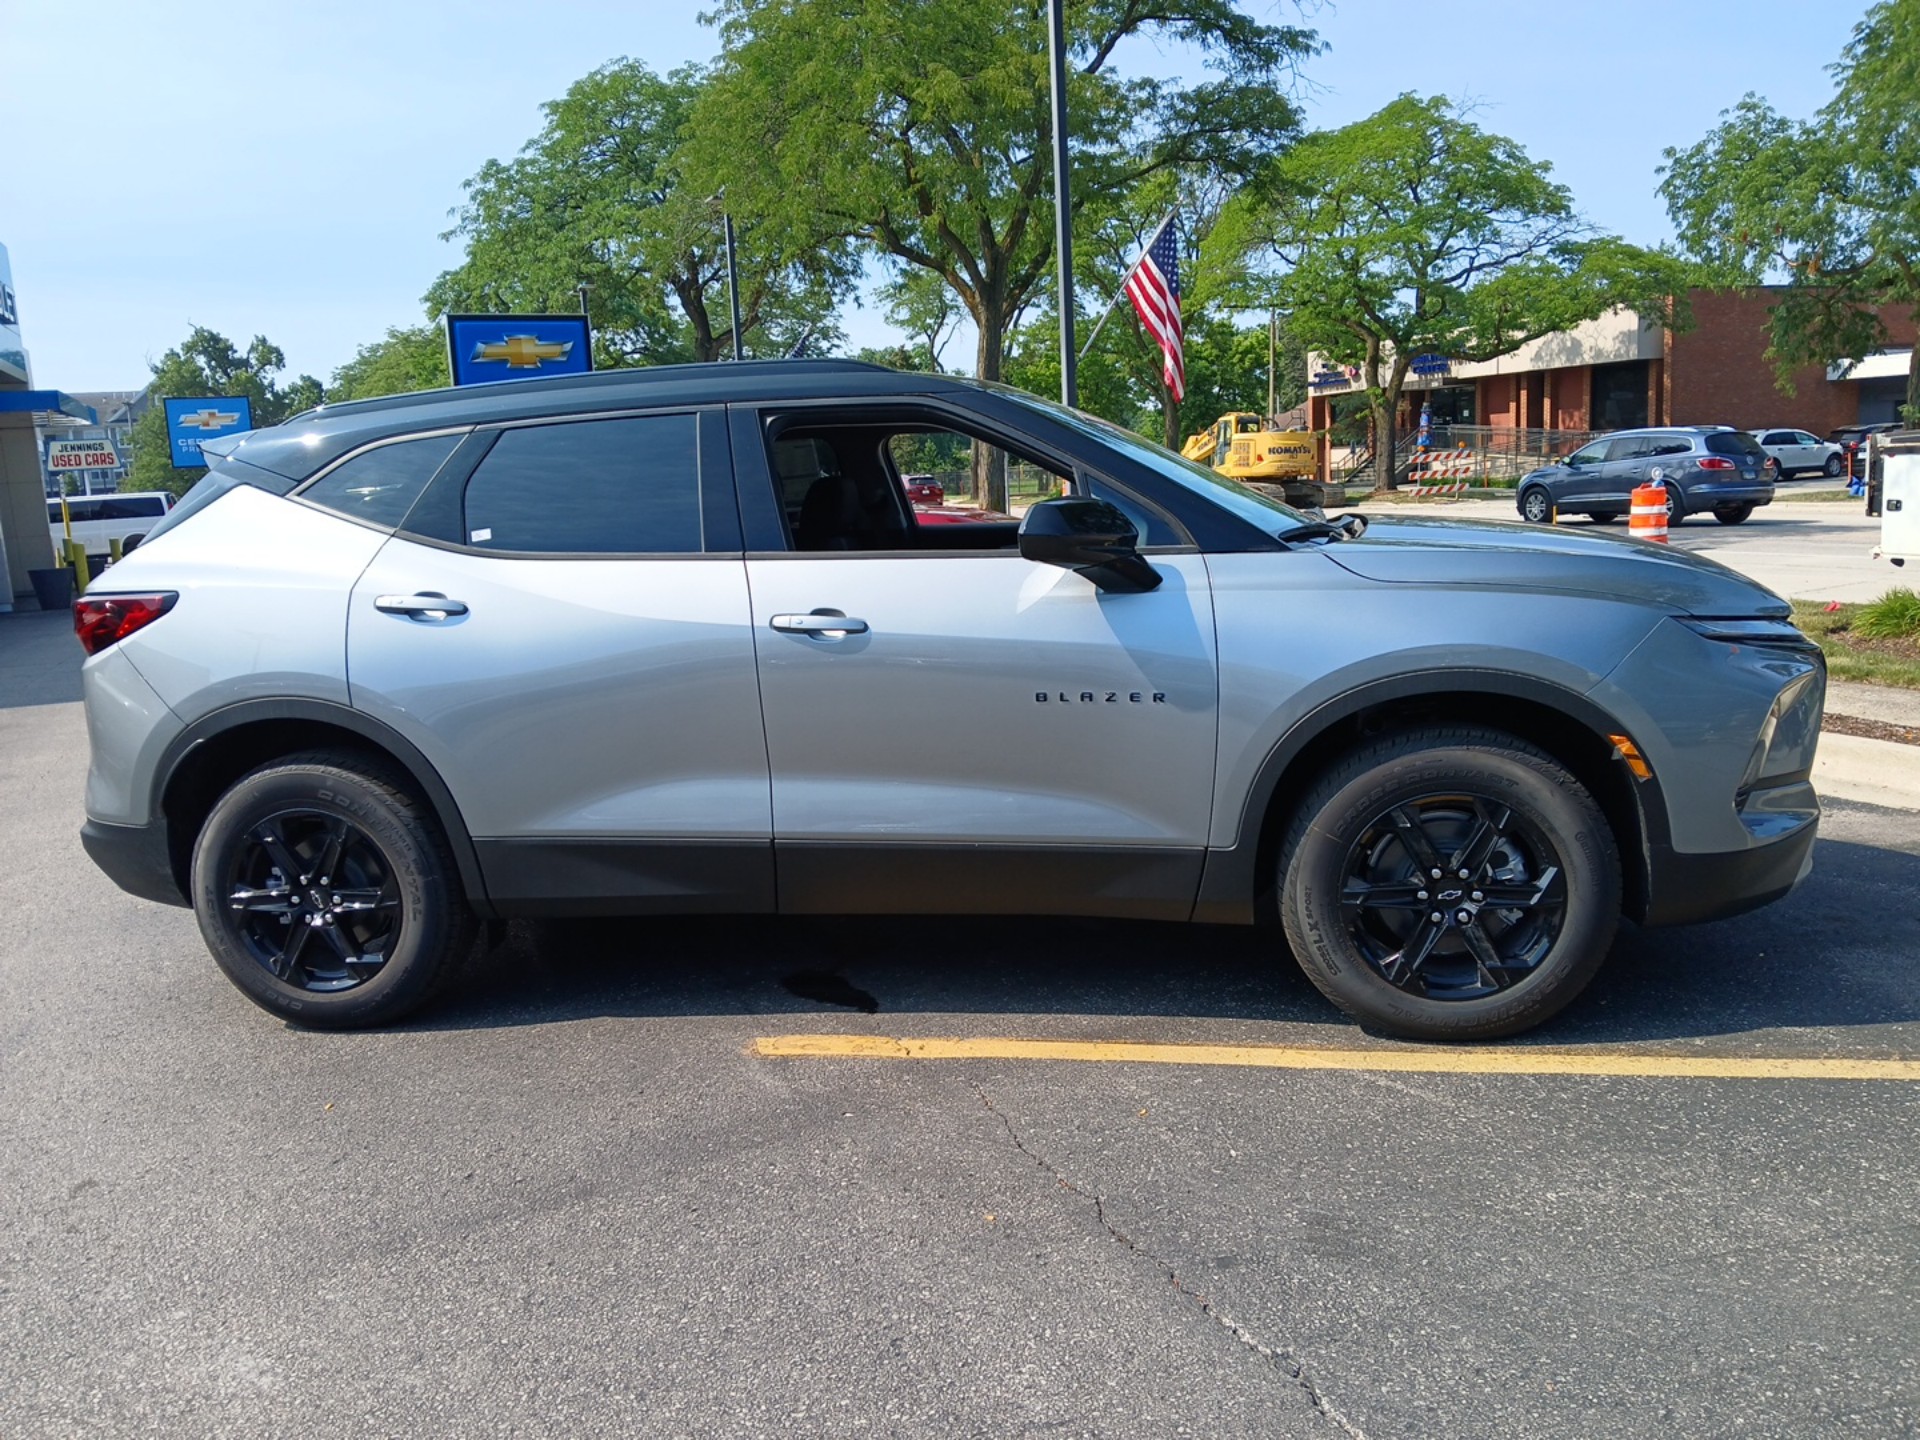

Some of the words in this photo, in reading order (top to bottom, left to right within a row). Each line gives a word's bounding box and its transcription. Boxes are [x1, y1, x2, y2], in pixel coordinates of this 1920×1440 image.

[58, 442, 105, 453] JENNINGS
[51, 454, 82, 467] USED
[84, 452, 115, 466] CARS
[1035, 691, 1166, 703] BLAZER
